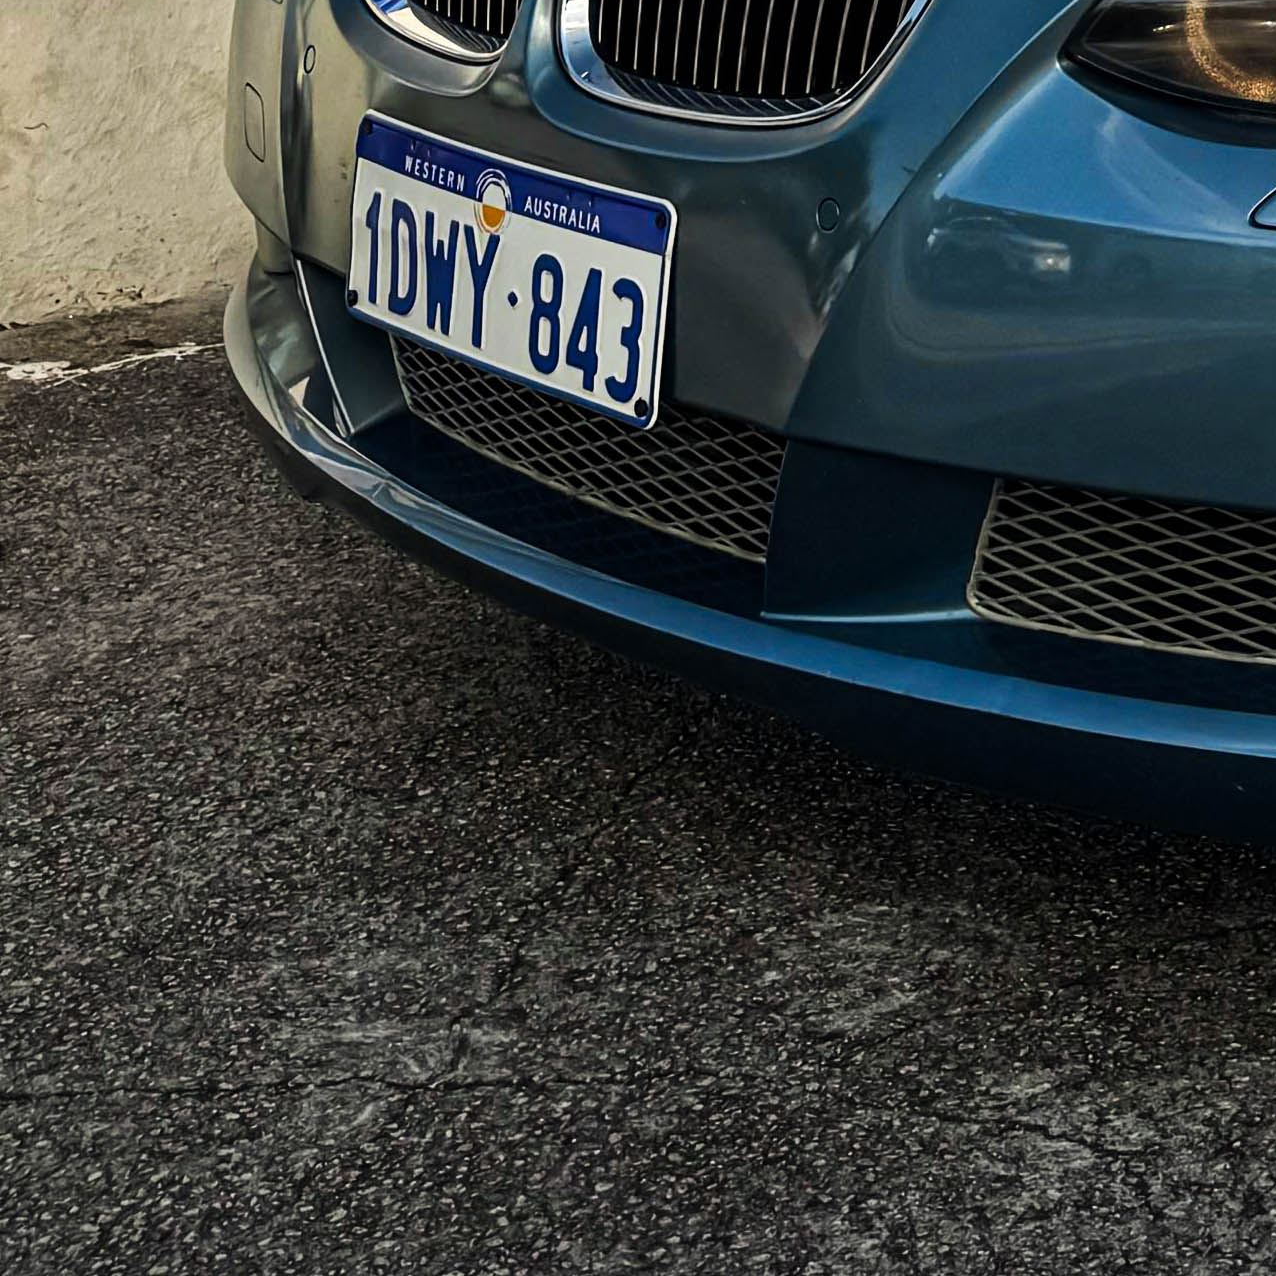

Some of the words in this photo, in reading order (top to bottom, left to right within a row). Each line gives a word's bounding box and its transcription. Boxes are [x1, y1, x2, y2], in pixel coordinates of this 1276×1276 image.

[404, 154, 465, 193] WESTERN
[523, 195, 601, 234] AUSTRALIA
[528, 253, 644, 404] 843
